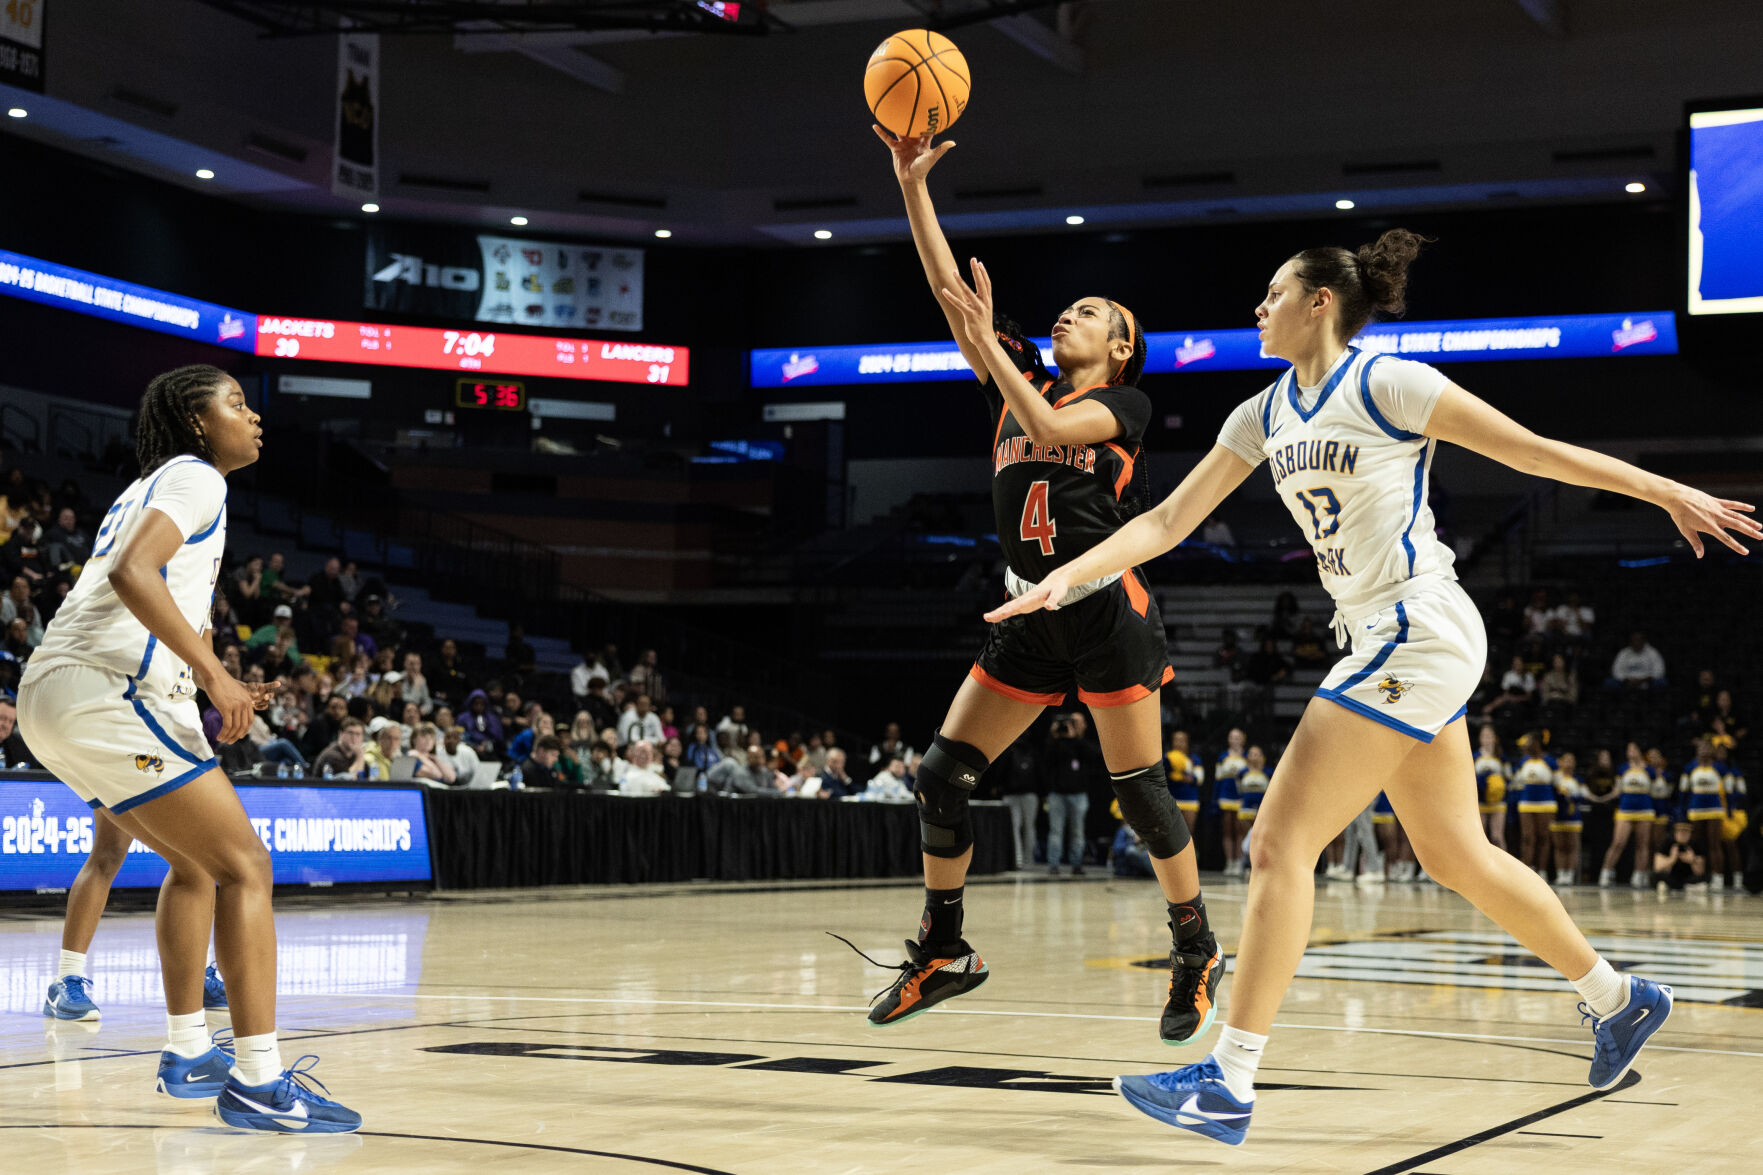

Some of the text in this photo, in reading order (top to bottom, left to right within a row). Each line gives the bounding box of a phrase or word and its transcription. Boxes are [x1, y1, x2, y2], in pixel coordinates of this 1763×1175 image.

[258, 318, 335, 339] JACKETS
[443, 331, 496, 357] 7:04
[601, 343, 675, 364] LANCERS
[646, 363, 670, 383] 31
[1020, 480, 1056, 556] 4
[1296, 485, 1342, 540] 13
[2, 815, 93, 855] 2024-25
[274, 817, 412, 853] CHAMPIONSHIPS
